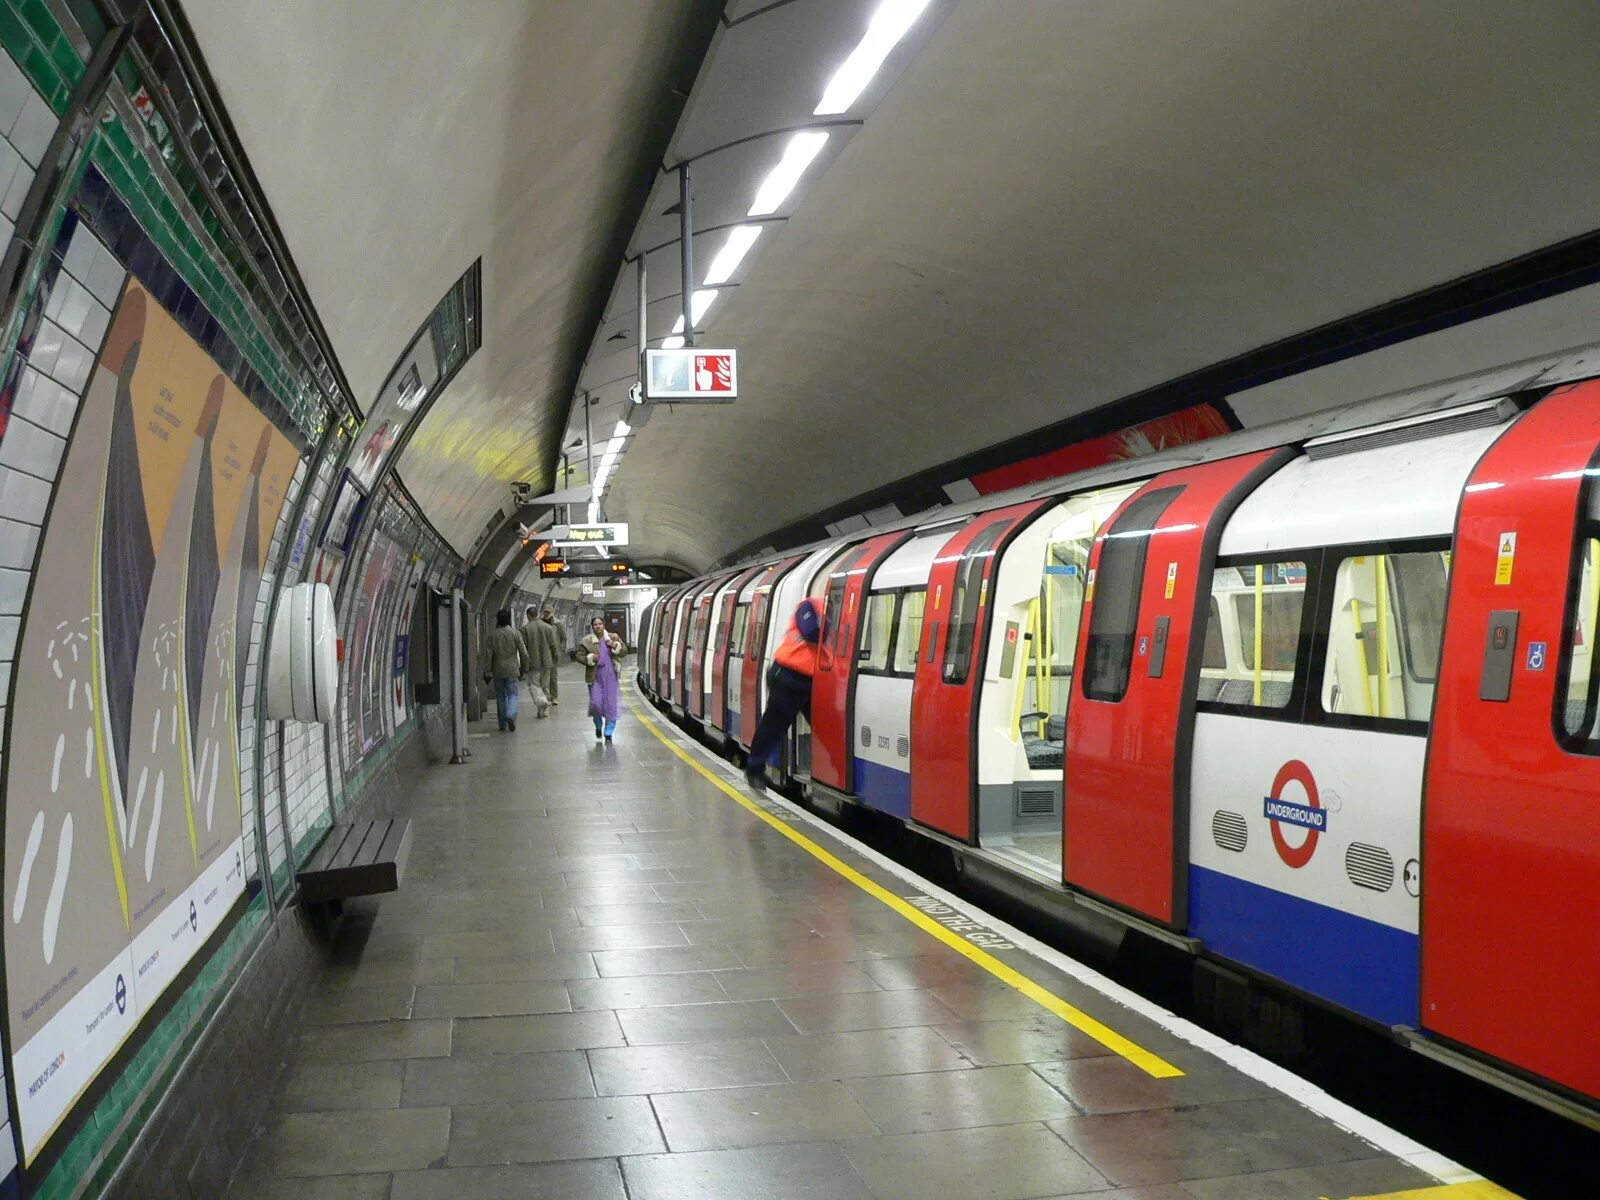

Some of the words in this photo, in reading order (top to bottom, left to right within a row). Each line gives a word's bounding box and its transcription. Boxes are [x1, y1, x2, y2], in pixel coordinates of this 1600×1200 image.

[588, 530, 604, 539] out
[1267, 802, 1323, 826] UNDERGROUND
[904, 896, 952, 915] MIND
[938, 916, 981, 931] THE
[965, 933, 1016, 950] GAP
[29, 1075, 44, 1098] MAYOR
[48, 1051, 65, 1076] LONDON
